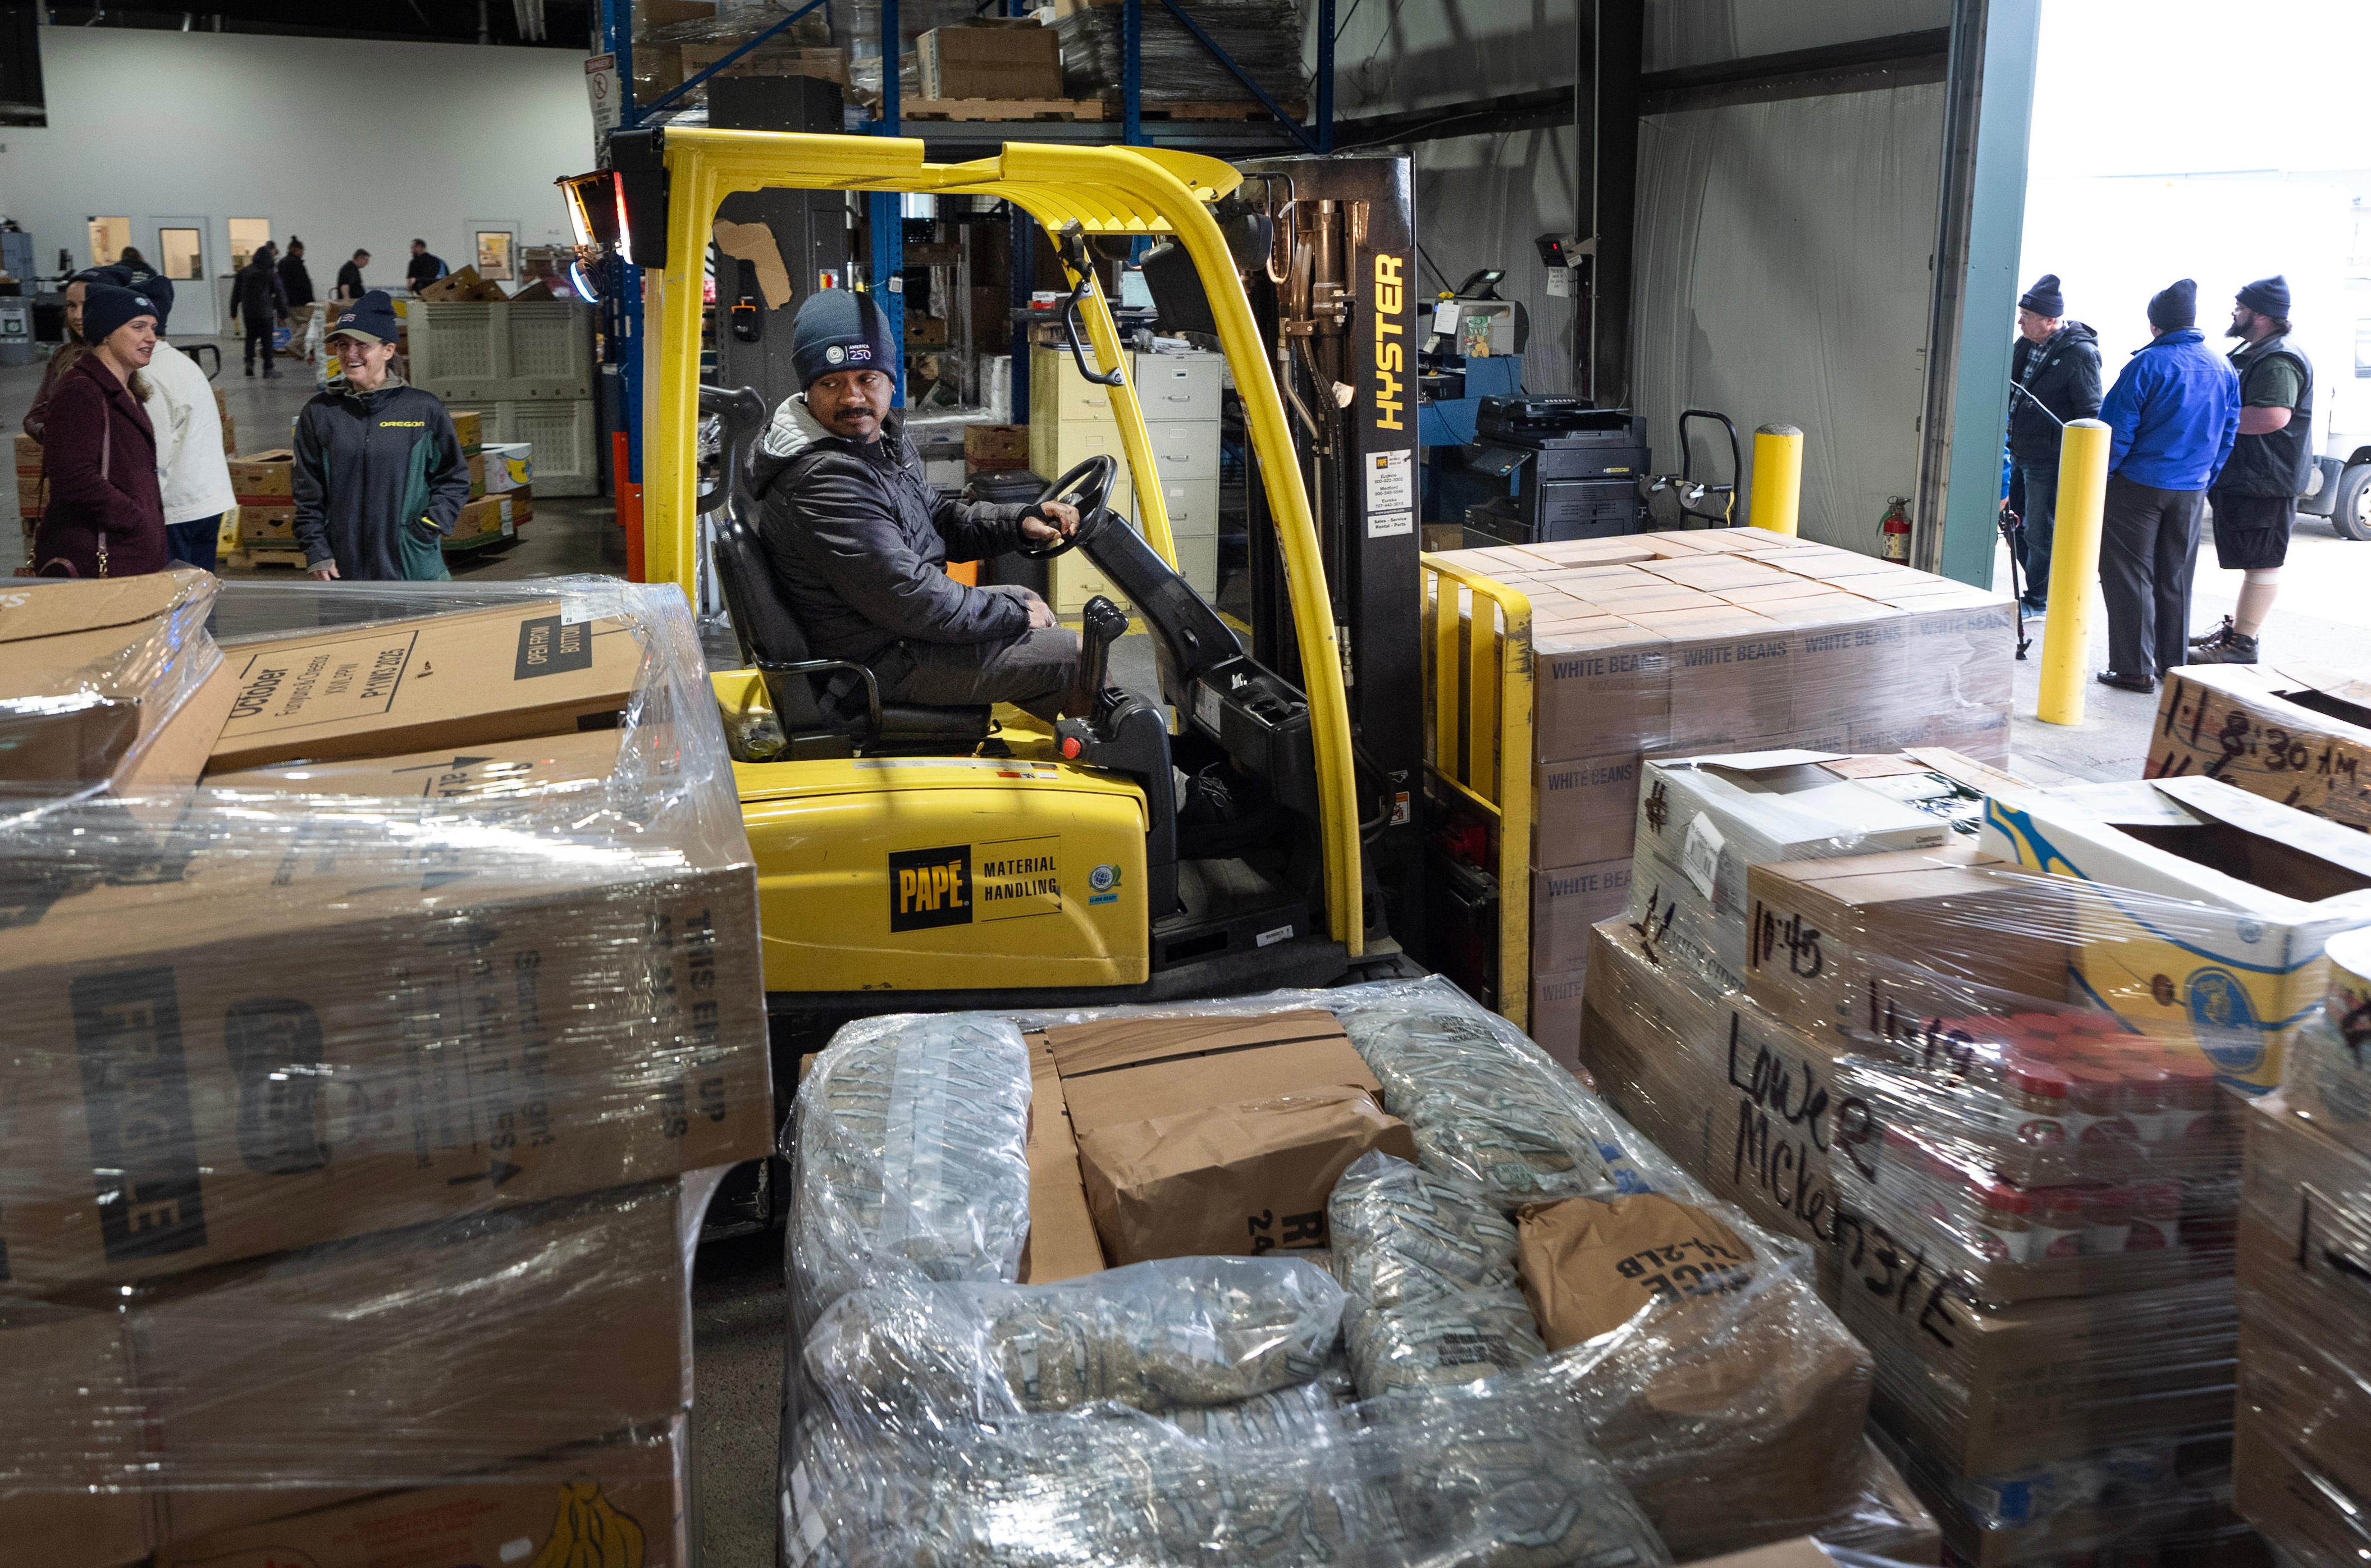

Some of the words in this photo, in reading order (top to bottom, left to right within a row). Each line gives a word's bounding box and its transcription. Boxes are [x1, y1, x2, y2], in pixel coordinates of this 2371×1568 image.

[1375, 254, 1403, 430] HYSTER
[849, 349, 871, 360] 250
[529, 625, 550, 644] FROM
[1804, 633, 1850, 653] WHITE
[1854, 625, 1901, 646] BEANS
[374, 648, 405, 668] 2025
[527, 644, 549, 665] OPEN
[1684, 646, 1732, 667] WHITE
[1737, 642, 1787, 661] BEANS
[1552, 658, 1604, 680] WHITE
[1548, 770, 1588, 790] WHITE
[1591, 764, 1632, 785] BEANS
[899, 860, 963, 914] PAPÉ
[984, 856, 1056, 878] MATERIAL
[984, 877, 1057, 901] HANDLING
[1548, 875, 1598, 898] WHITE
[686, 908, 716, 991] THIS
[1542, 980, 1582, 1001] WHITE
[698, 1077, 726, 1122] UP
[101, 999, 181, 1233] FRAGLE
